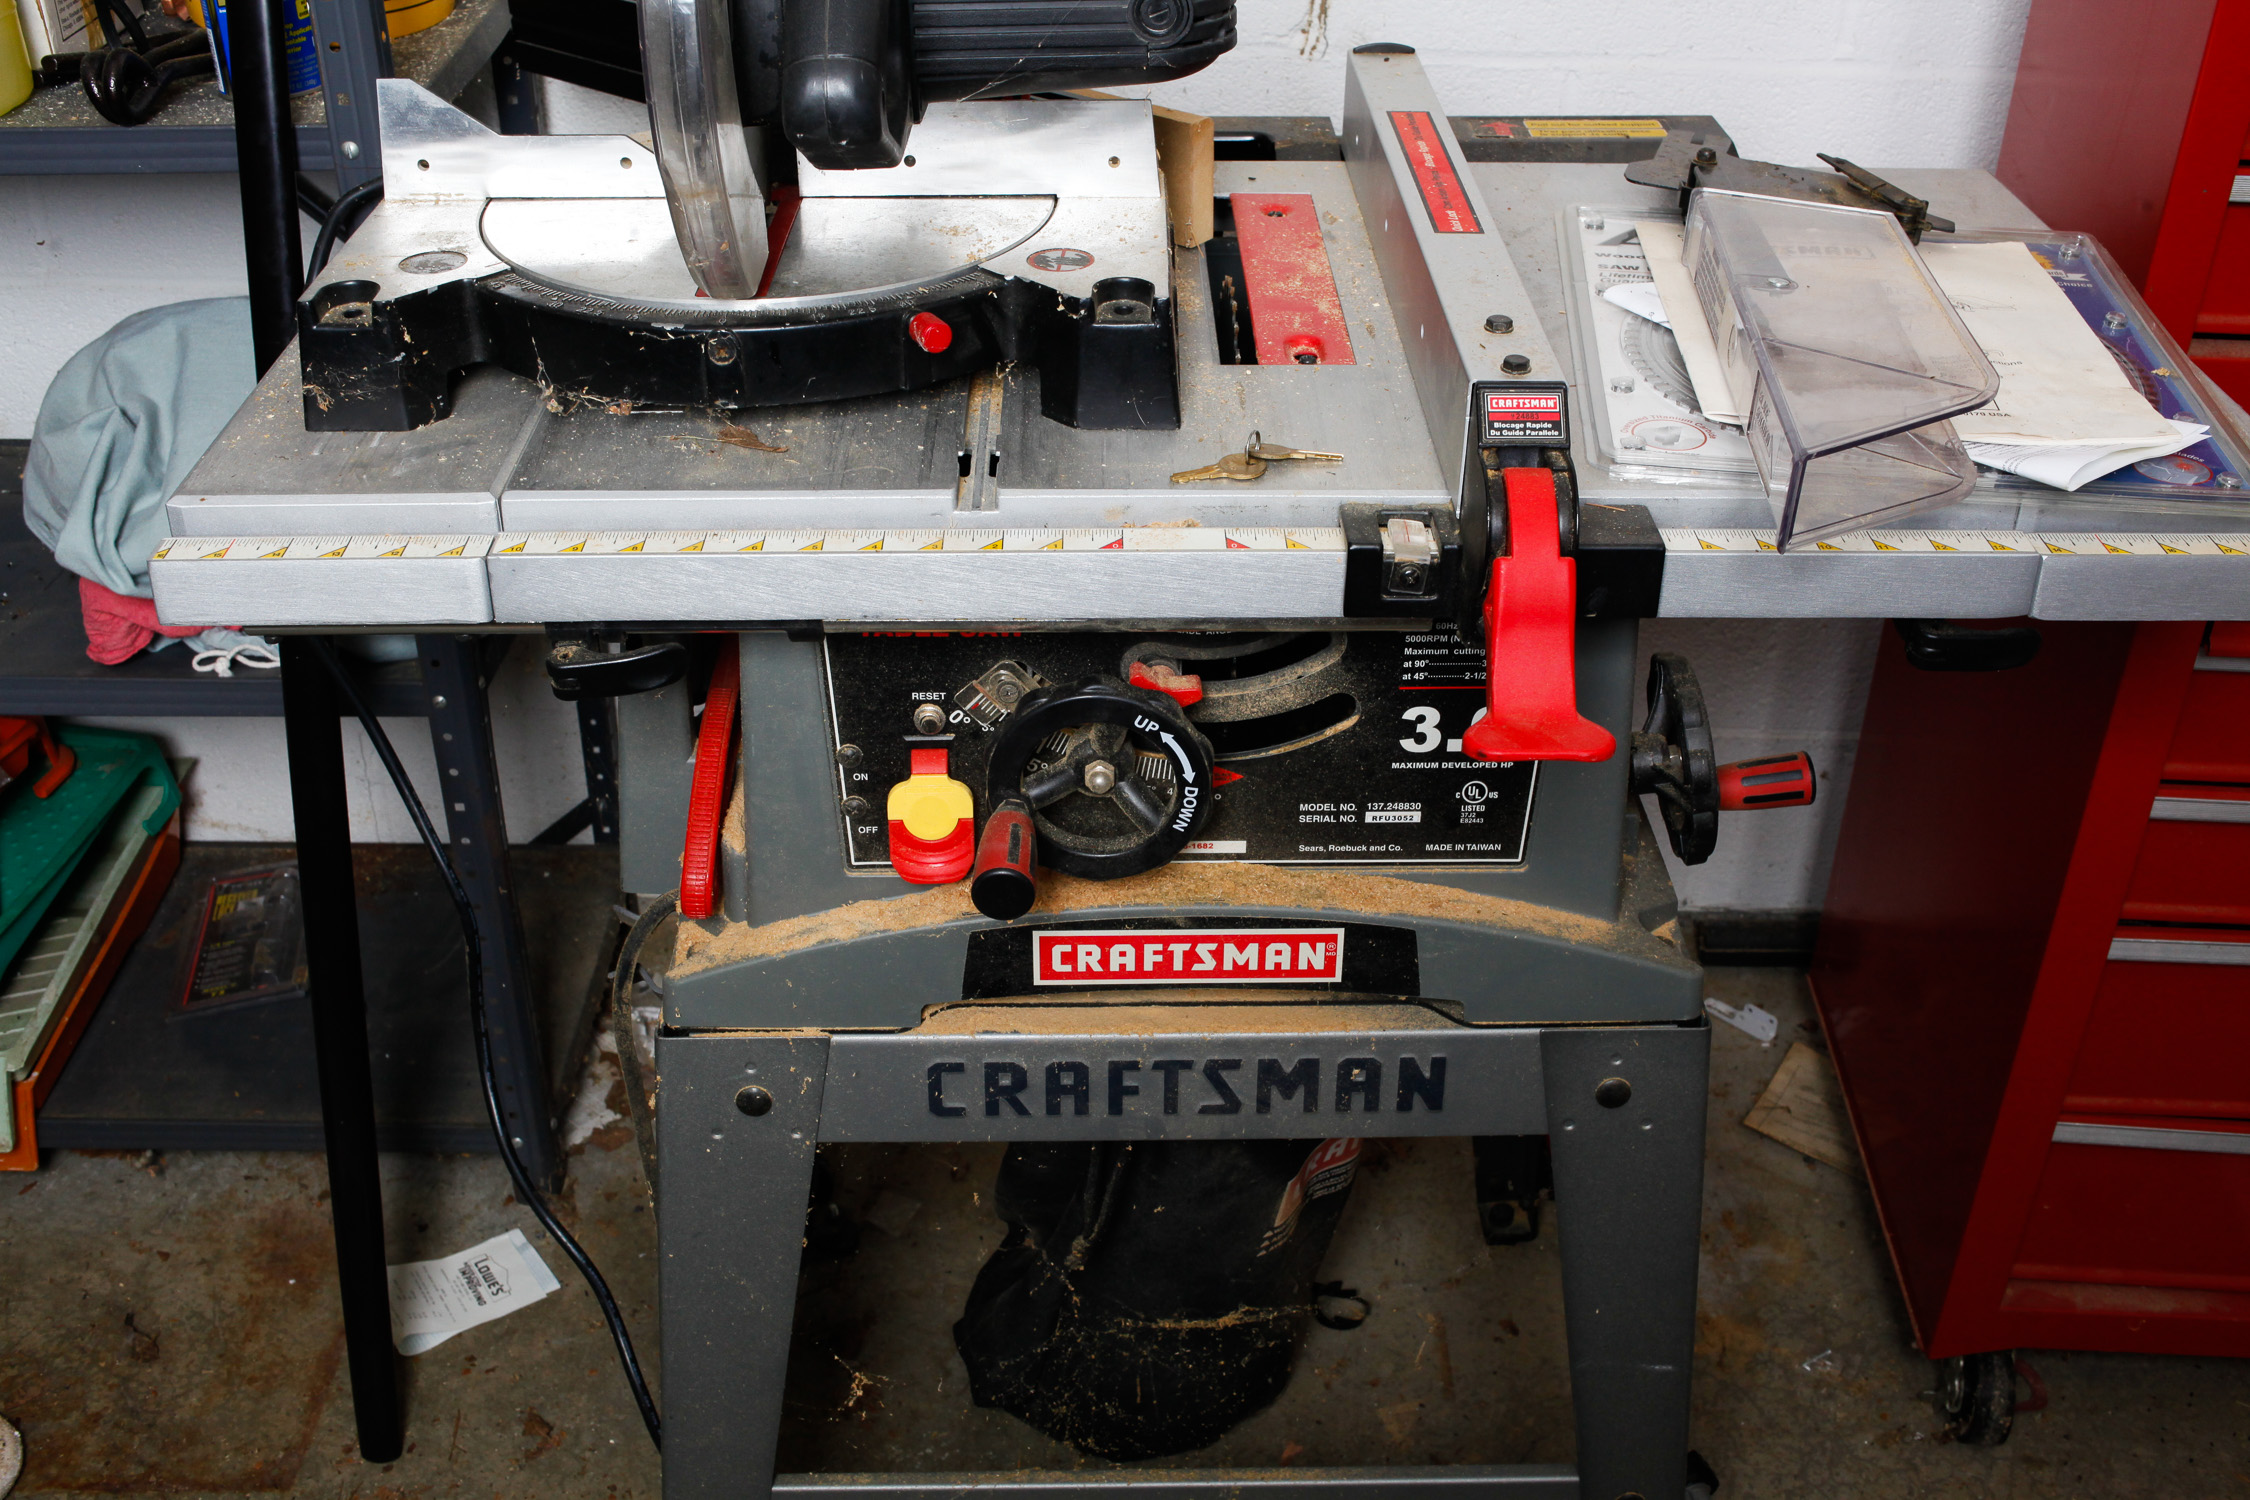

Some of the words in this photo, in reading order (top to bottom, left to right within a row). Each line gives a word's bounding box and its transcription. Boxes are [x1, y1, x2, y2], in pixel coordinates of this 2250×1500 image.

[1492, 399, 1554, 408] CRAFTSMAN
[1493, 422, 1524, 430] Blocage
[1526, 422, 1552, 430] Rapide
[1650, 414, 1693, 424] Titanium
[1694, 422, 1718, 440] Carbide
[1435, 622, 1458, 630] 60Hz
[1405, 634, 1448, 643] 5000RPM
[1404, 647, 1449, 656] Maximum
[1453, 647, 1486, 657] cutting
[911, 692, 946, 700] RESET
[1133, 714, 1160, 733] UP
[1399, 705, 1488, 753] 3.
[1441, 761, 1498, 769] DEVELOPED
[1500, 761, 1514, 769] HP
[853, 773, 868, 781] ON
[1172, 786, 1200, 833] DOWN
[1299, 803, 1337, 812] MODEL
[1339, 803, 1358, 812] NO.
[1367, 802, 1422, 811] 137.248830
[1299, 815, 1337, 823] SERIAL
[1339, 815, 1358, 823] NO.
[858, 826, 878, 834] OFF
[1298, 844, 1327, 853] Sears,
[1328, 844, 1367, 852] Roebuck
[1369, 844, 1386, 852] and
[1388, 844, 1403, 852] Co.
[1425, 843, 1453, 851] MADE
[1455, 843, 1465, 851] IN
[1466, 843, 1502, 851] TAIWAN
[1051, 942, 1326, 972] CRAFTSMAN
[927, 1056, 1447, 1117] CRAFTSMAN
[474, 1257, 505, 1297] LOWE'S
